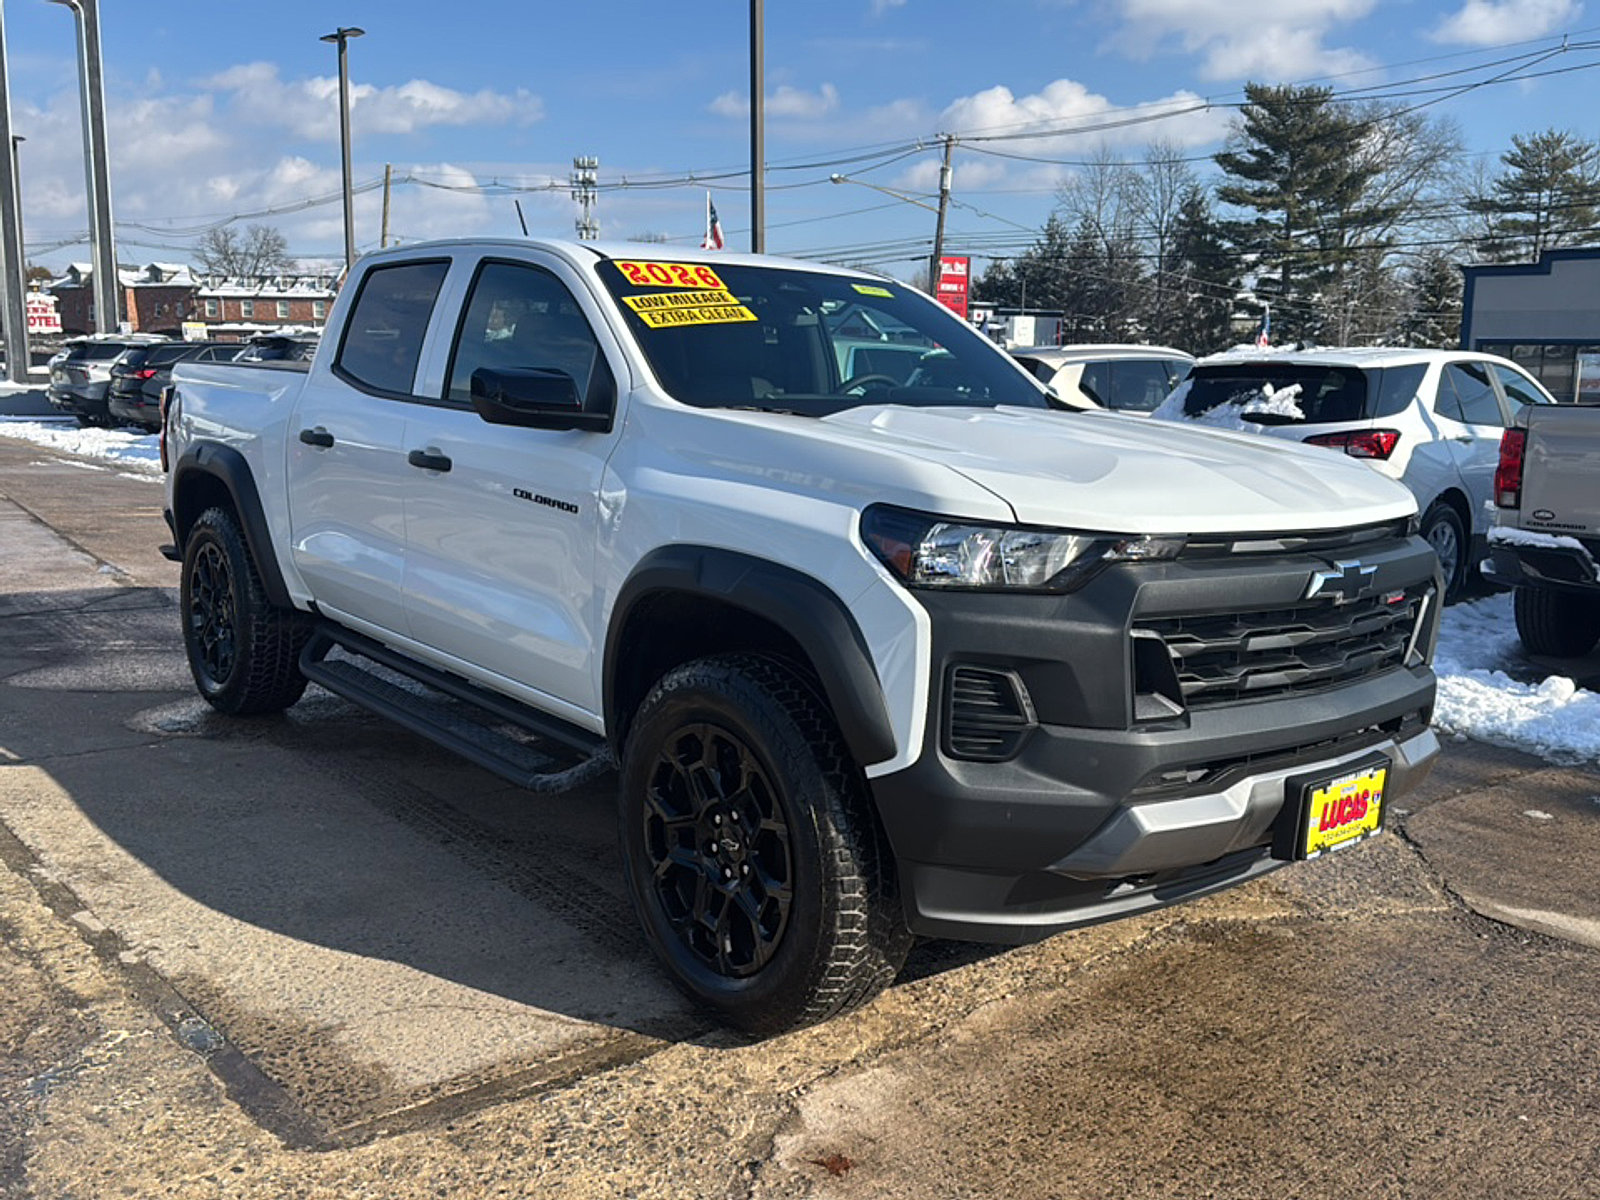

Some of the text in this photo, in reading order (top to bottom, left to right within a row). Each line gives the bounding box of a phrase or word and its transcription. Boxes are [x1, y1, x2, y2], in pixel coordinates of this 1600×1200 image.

[621, 263, 720, 287] 2026
[631, 292, 731, 309] LOW MILEAGE
[27, 316, 62, 328] OTEL
[648, 307, 748, 324] EXTRA CLEAN
[513, 488, 578, 514] COLORADO
[1319, 789, 1369, 832] LUCAS
